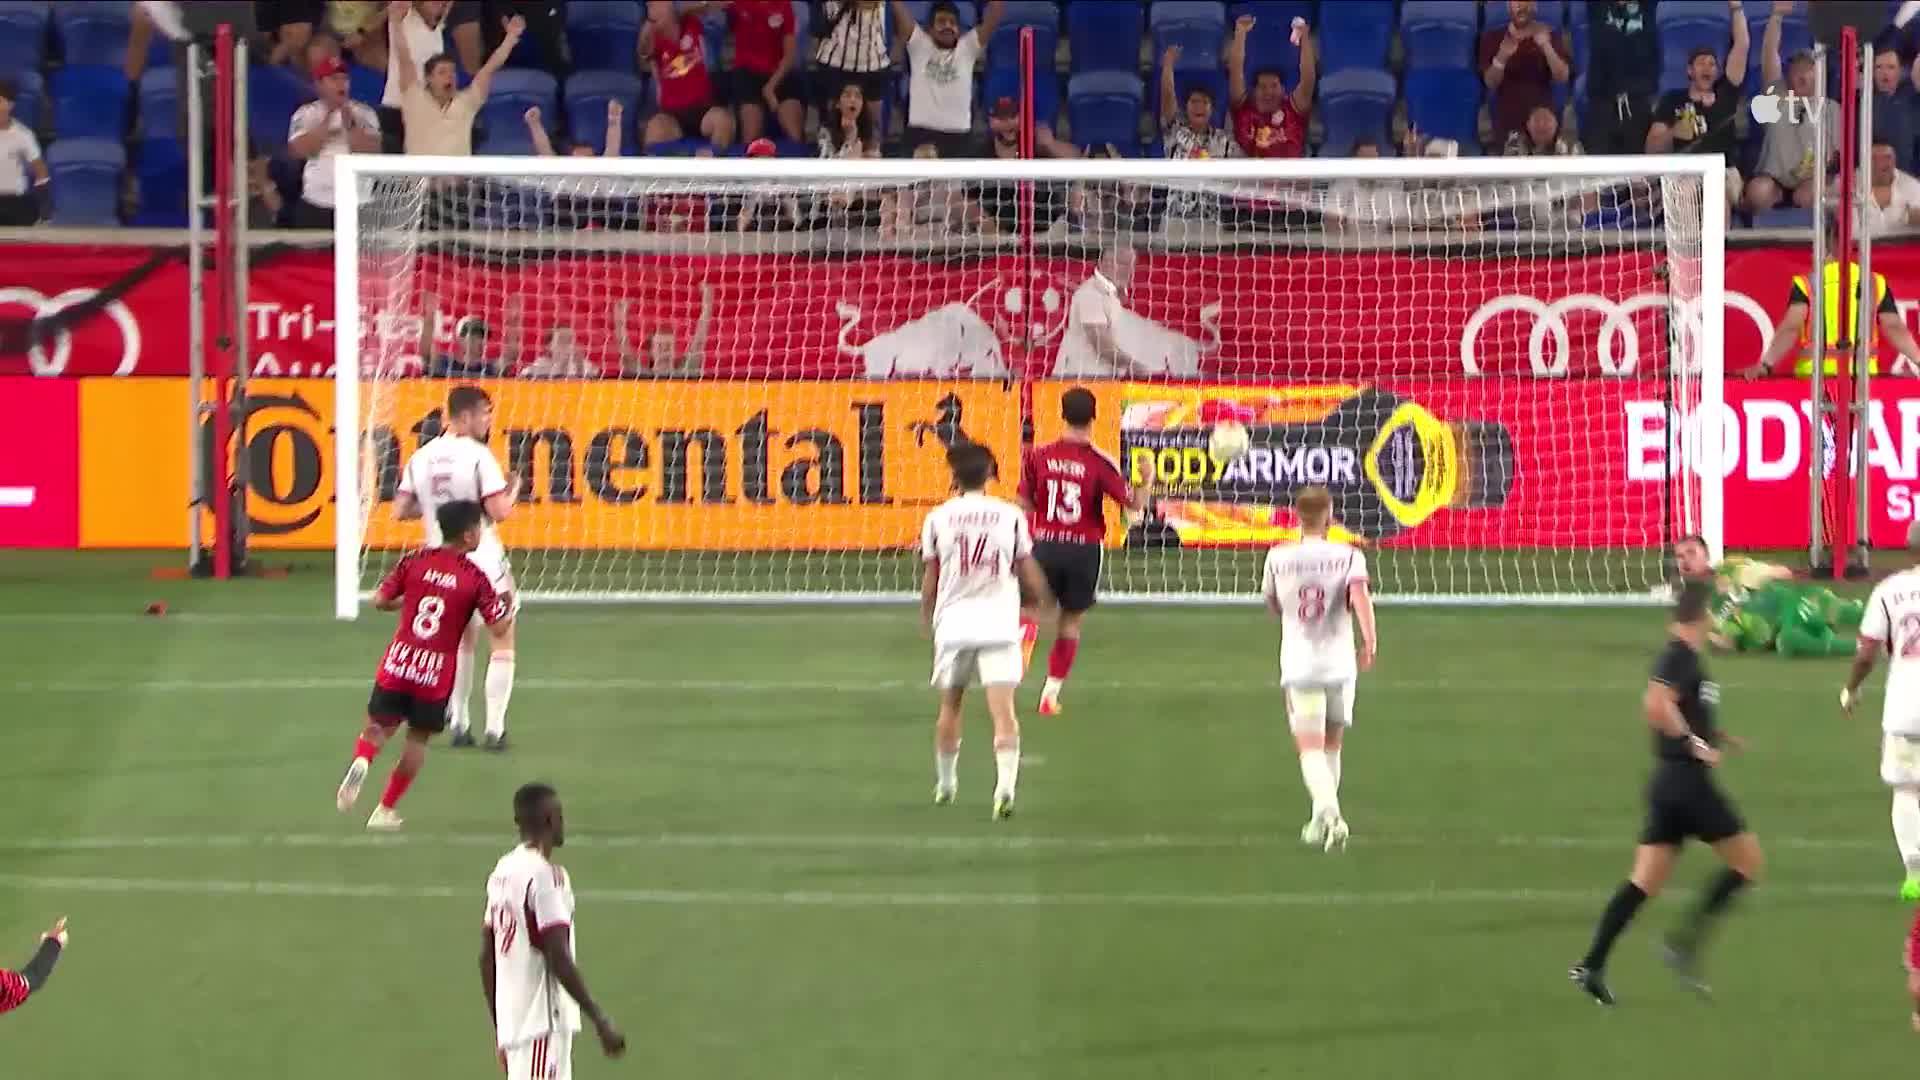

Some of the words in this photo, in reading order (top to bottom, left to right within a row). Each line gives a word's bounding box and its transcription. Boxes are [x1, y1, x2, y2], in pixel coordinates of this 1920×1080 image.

[1046, 479, 1082, 526] 13
[953, 530, 1001, 577] 14
[411, 594, 446, 640] 8
[1298, 583, 1326, 625] 8
